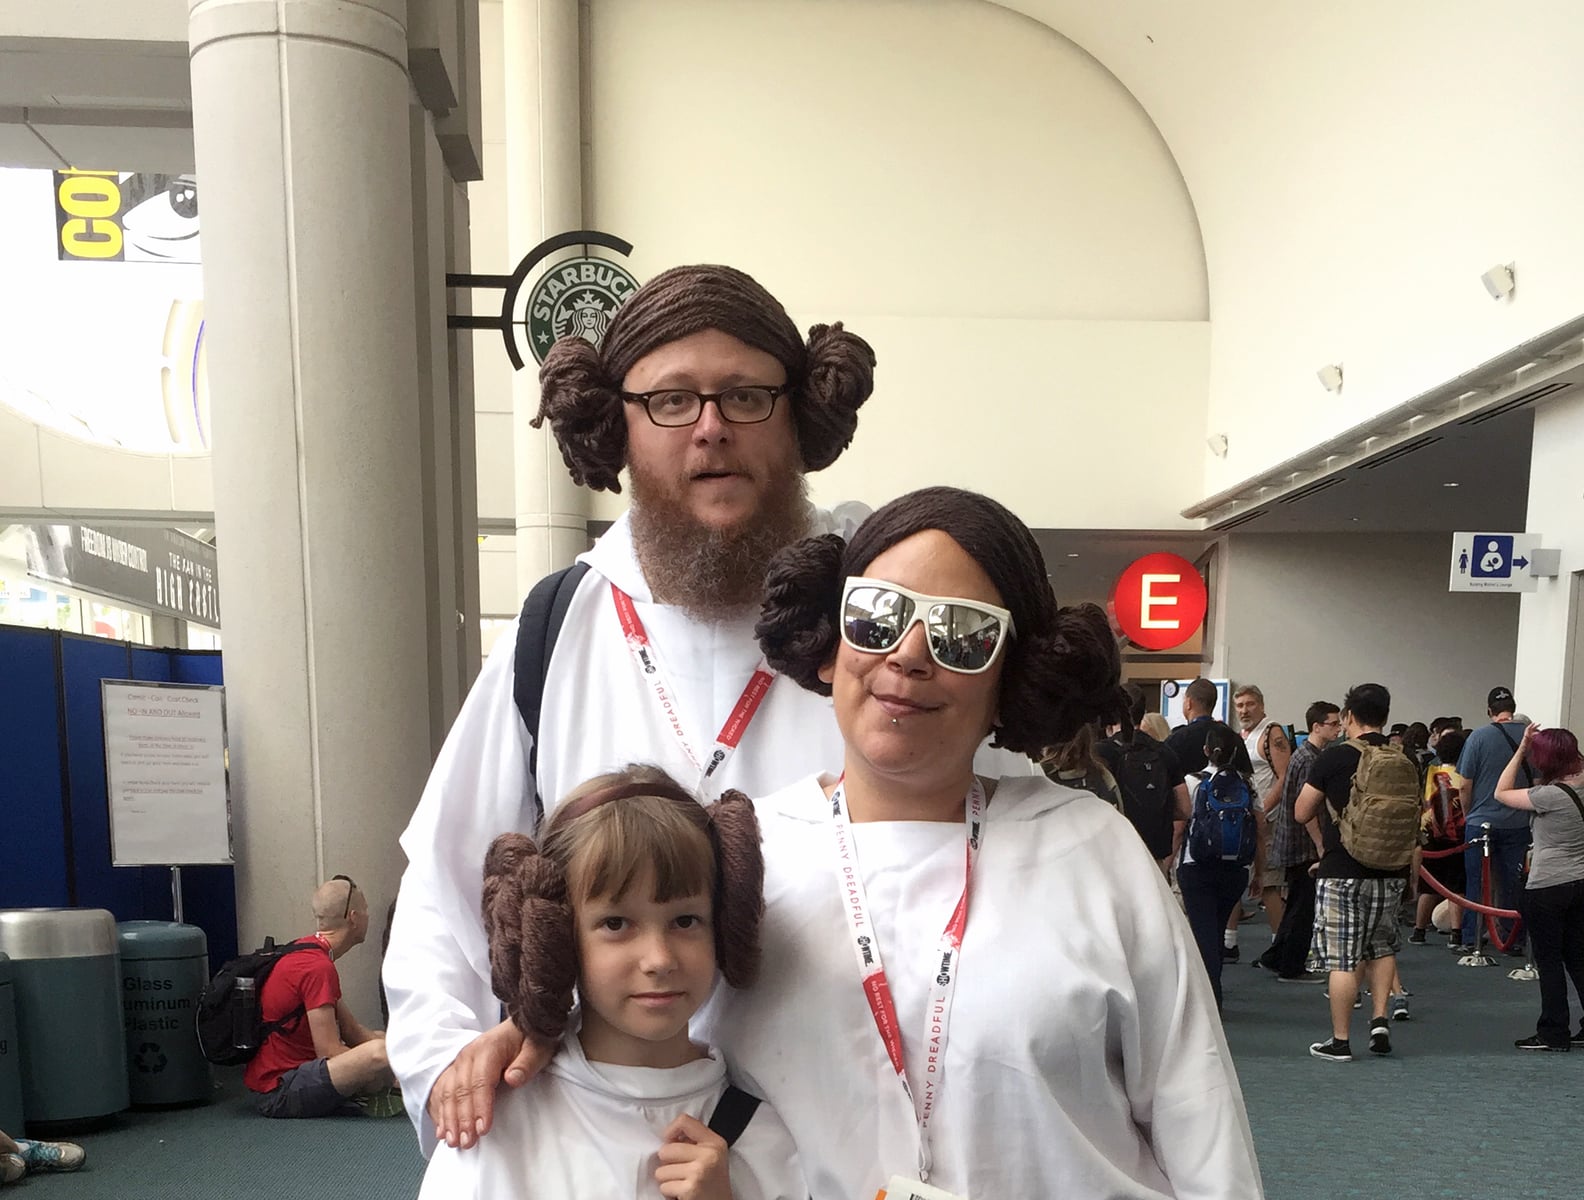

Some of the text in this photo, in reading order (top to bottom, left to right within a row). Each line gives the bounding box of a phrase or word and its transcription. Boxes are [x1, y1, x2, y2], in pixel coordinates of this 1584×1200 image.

[58, 168, 123, 258] CO
[156, 566, 184, 612] HIGH
[169, 552, 180, 571] THE
[202, 566, 212, 584] THE
[1141, 574, 1180, 629] E
[654, 680, 684, 737] DREADFUL
[843, 866, 865, 928] DREADFUL
[123, 976, 173, 991] Glass
[922, 995, 946, 1128] PENNY DREADFUL
